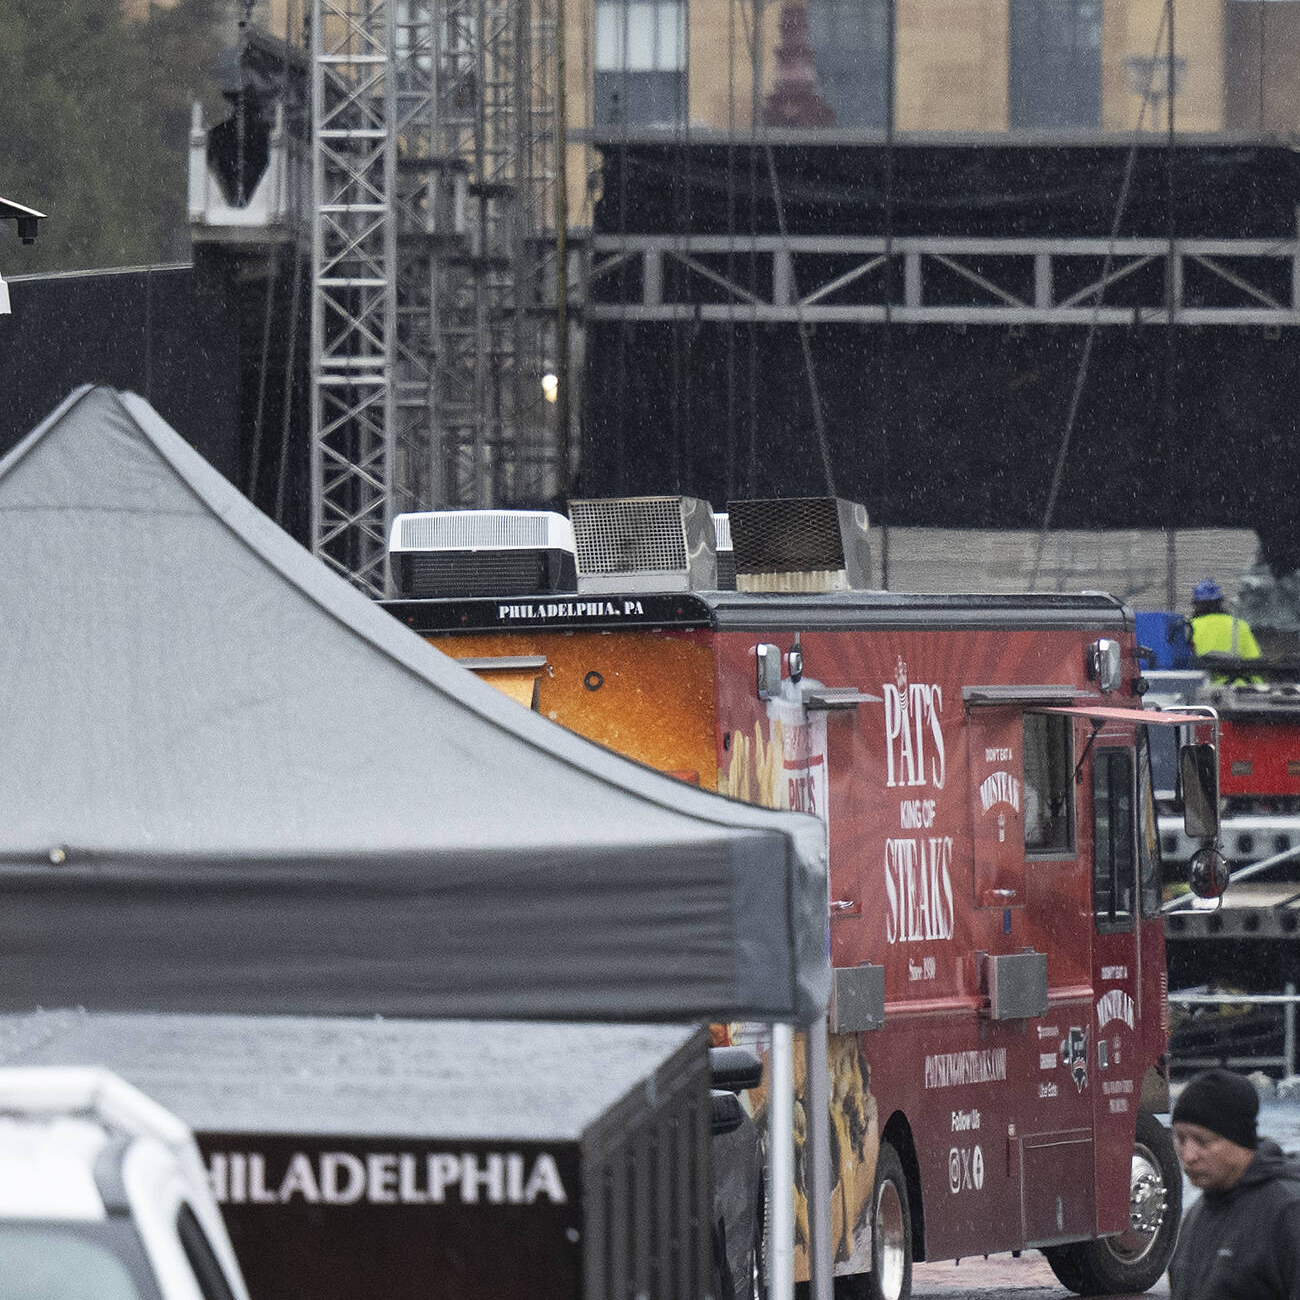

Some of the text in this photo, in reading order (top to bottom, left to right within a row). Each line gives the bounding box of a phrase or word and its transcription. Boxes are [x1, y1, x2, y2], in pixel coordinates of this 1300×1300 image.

[624, 601, 644, 615] PA
[882, 683, 945, 790] PAT'S
[900, 798, 936, 828] KING OF
[885, 836, 954, 944] STEAKS
[204, 1151, 567, 1205] HILADELPHIA
